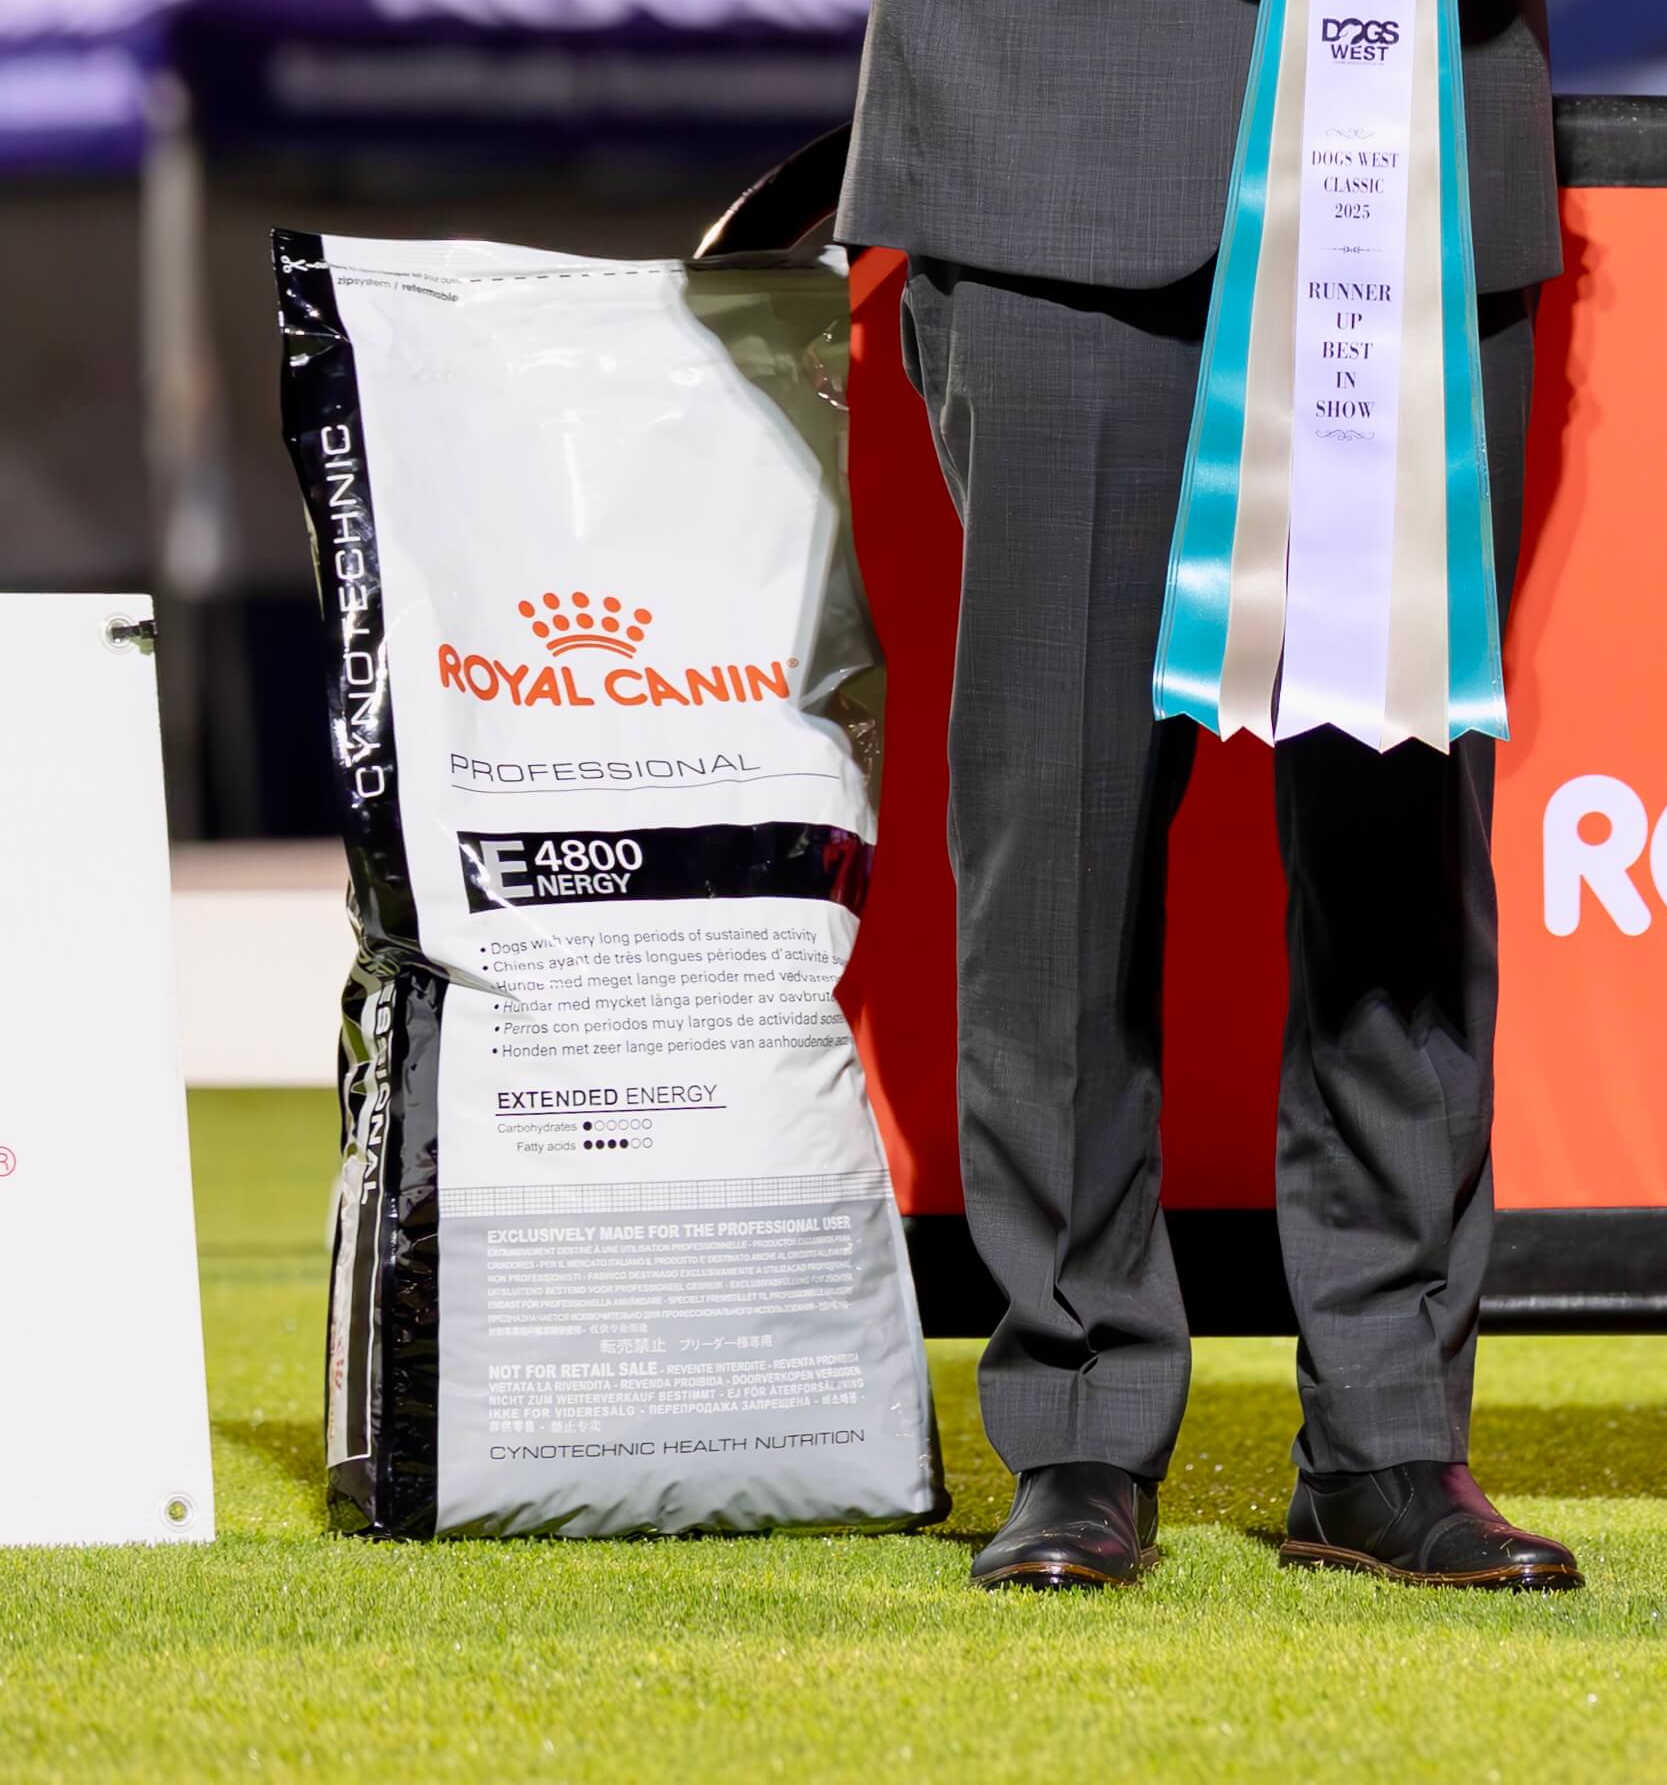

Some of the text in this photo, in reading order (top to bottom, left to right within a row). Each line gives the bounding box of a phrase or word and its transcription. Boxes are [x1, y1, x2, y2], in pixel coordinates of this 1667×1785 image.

[1321, 18, 1400, 45] DOGS
[1331, 44, 1389, 61] WEST
[1311, 150, 1400, 168] DOGS WEST
[1323, 176, 1384, 194] CLASSIC
[1335, 203, 1370, 219] 2025
[1309, 282, 1391, 302] RUNNER
[1336, 312, 1363, 330] UP
[1322, 342, 1374, 359] BEST
[1336, 371, 1356, 389] IN
[1315, 400, 1375, 419] SHOW
[320, 423, 386, 799] CYNOTECHNIC
[438, 643, 595, 707] ROYAL
[450, 753, 761, 783] PROFESSIONAL
[534, 838, 643, 872] 4800
[491, 941, 527, 955] Dogs
[566, 935, 595, 948] very
[600, 932, 630, 946] long
[634, 929, 685, 945] periods
[689, 929, 702, 941] of
[706, 928, 768, 942] sustained
[773, 928, 817, 944] activity
[494, 960, 544, 973] Chiens
[594, 952, 611, 965] de
[615, 951, 642, 964] très
[646, 949, 703, 966] longues
[707, 948, 767, 964] périodes
[588, 975, 632, 989] meget
[637, 972, 677, 988] lange
[681, 970, 739, 986] perioder
[744, 970, 775, 983] med
[503, 1000, 552, 1013] Hundar
[558, 998, 590, 1011] med
[595, 995, 646, 1010] mycket
[695, 992, 753, 1008] perioder
[758, 992, 775, 1003] av
[503, 1022, 549, 1035] Perros
[553, 1021, 580, 1033] con
[584, 1018, 648, 1033] periodos
[652, 1017, 684, 1031] muy
[688, 1015, 733, 1031] largos
[737, 1013, 754, 1026] de
[758, 1012, 818, 1026] actividad
[502, 1043, 557, 1057] Honden
[562, 1043, 589, 1055] met
[593, 1042, 622, 1054] zeer
[626, 1040, 663, 1055] lange
[667, 1038, 727, 1054] periodes
[730, 1038, 755, 1049] van
[758, 1035, 833, 1049] aanhoudende
[497, 1084, 718, 1110] EXTENDED ENERGY
[497, 1121, 577, 1135] Carbohydrates
[517, 1140, 576, 1155] Fatty acids
[487, 1215, 851, 1244] EXCLUSIVELY MADE FOR THE PROFESSIONAL USER
[488, 1365, 523, 1380] NOT
[526, 1364, 557, 1379] FOR
[561, 1363, 615, 1378] RETAIL
[619, 1361, 658, 1376] SALE
[666, 1363, 713, 1375] REVENTE
[715, 1360, 768, 1373] INTERDITE
[488, 1381, 536, 1393] VIETATA
[537, 1381, 552, 1392] LA
[554, 1379, 611, 1392] RIVENDITA
[620, 1378, 671, 1390] REVENDA
[674, 1375, 724, 1388] PROIBIDA
[488, 1395, 524, 1406] NICHT
[527, 1394, 553, 1406] ZUM
[556, 1391, 655, 1405] WEITERVERKAUF
[658, 1389, 716, 1402] BESTIMMT
[727, 1386, 740, 1399] EJ
[649, 1401, 738, 1415] ПЕРЕПРОДАЖА
[741, 1395, 810, 1411] ЗАПРЕЩЕНА
[488, 1405, 635, 1420] IKKE FOR VIDERESALG
[490, 1429, 865, 1460] CYNOTECHNIC HEALTH NUTRITION
